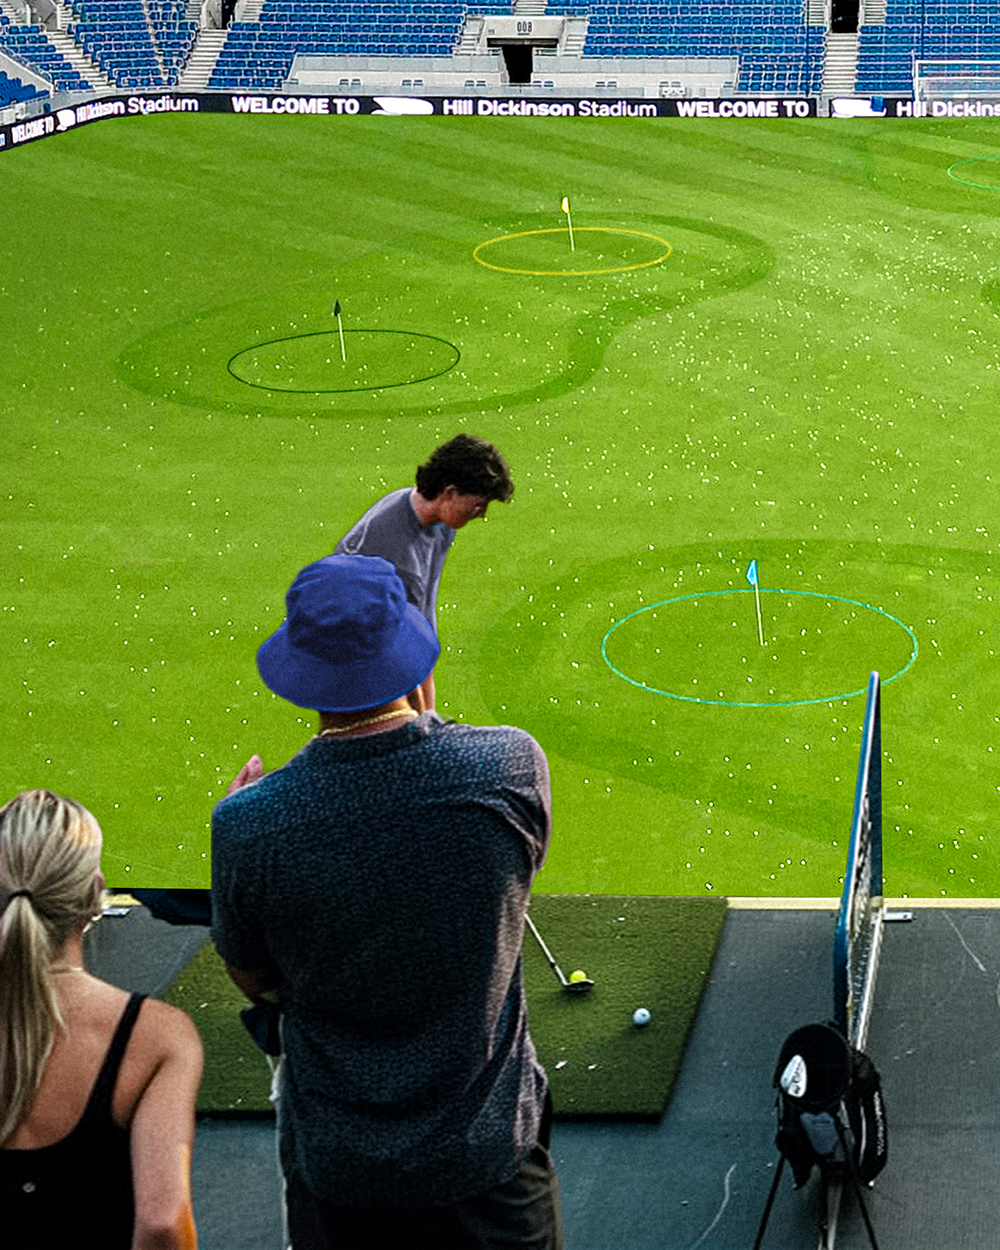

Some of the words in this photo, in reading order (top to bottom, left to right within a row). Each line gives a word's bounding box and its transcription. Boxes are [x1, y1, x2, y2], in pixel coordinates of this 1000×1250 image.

[517, 21, 532, 32] 008
[127, 95, 199, 115] Stadium
[231, 97, 329, 114] WELCOME
[333, 98, 360, 114] TO
[443, 99, 473, 115] Hill
[477, 99, 575, 116] Dickinson
[578, 100, 658, 117] Stadium
[676, 101, 779, 117] WELCOME
[783, 101, 810, 117] TO
